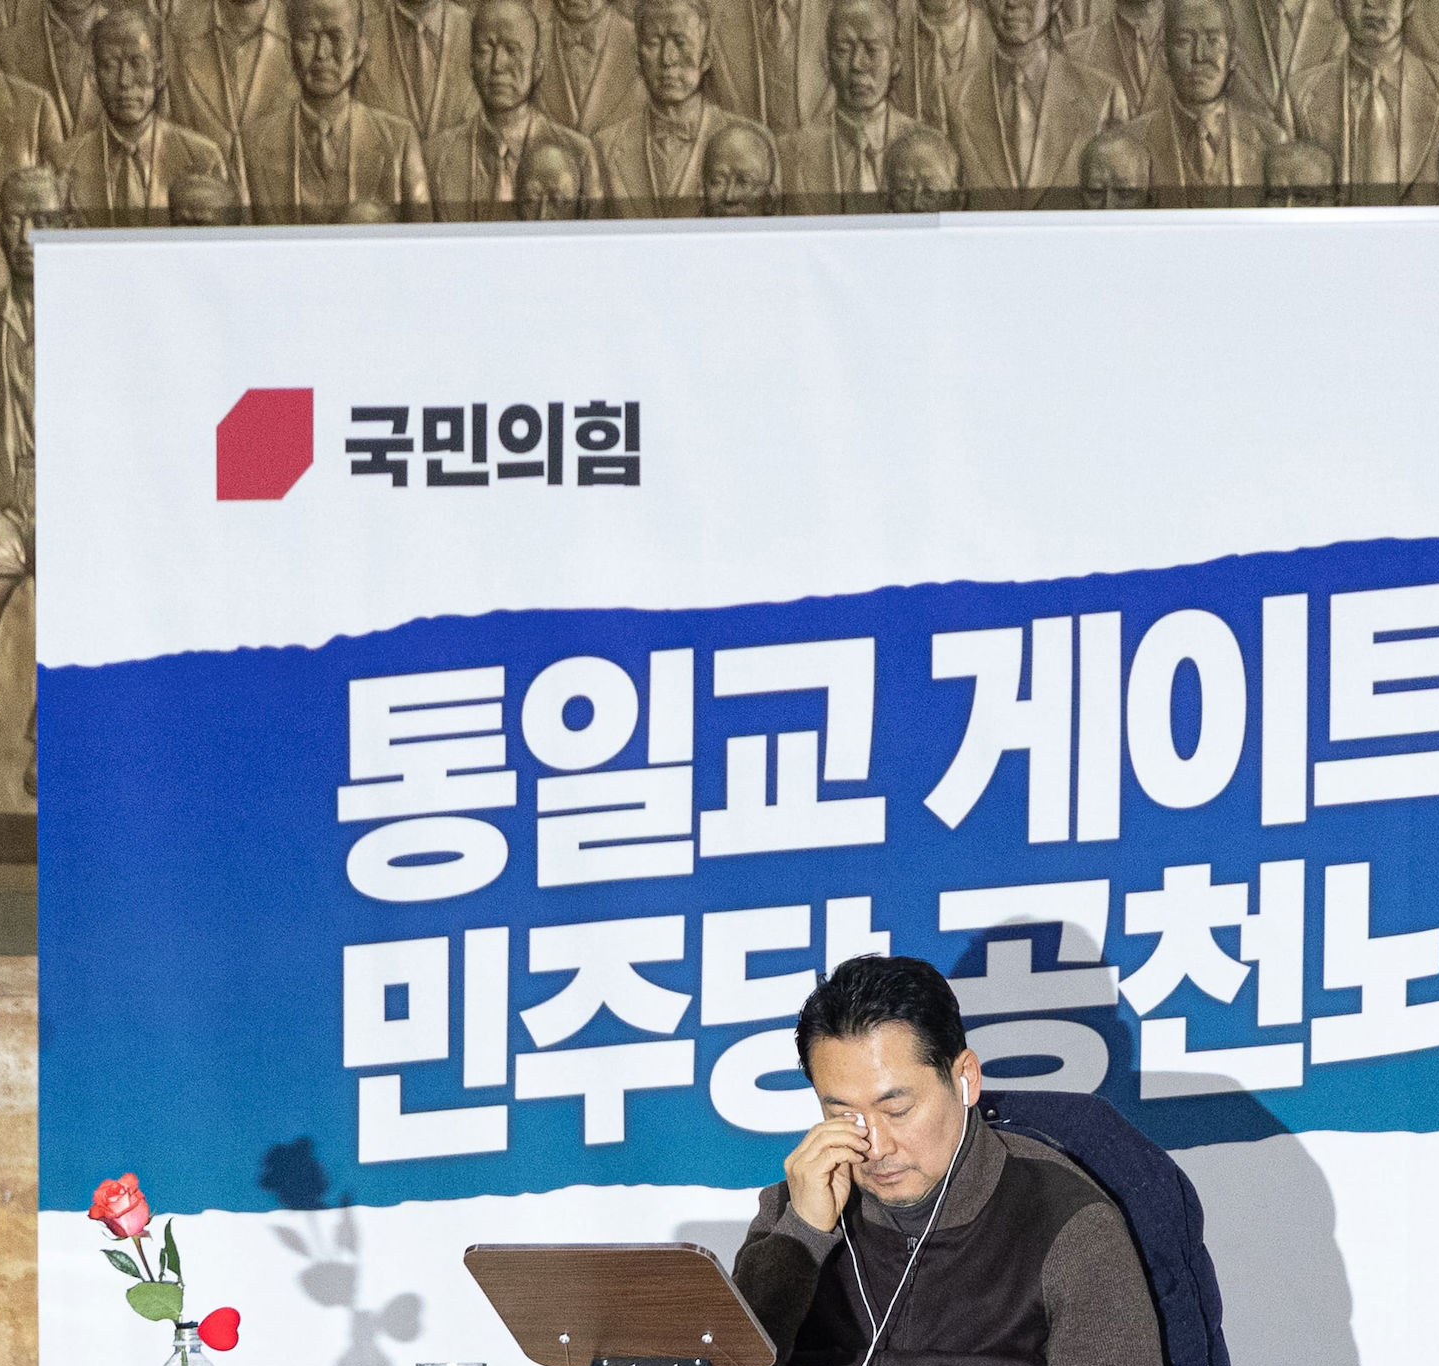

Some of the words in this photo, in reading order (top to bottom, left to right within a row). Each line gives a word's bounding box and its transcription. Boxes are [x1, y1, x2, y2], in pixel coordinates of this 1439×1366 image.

[345, 400, 642, 488] 국민의힘
[337, 636, 887, 903] 통일교
[342, 895, 892, 1164] 민주당
